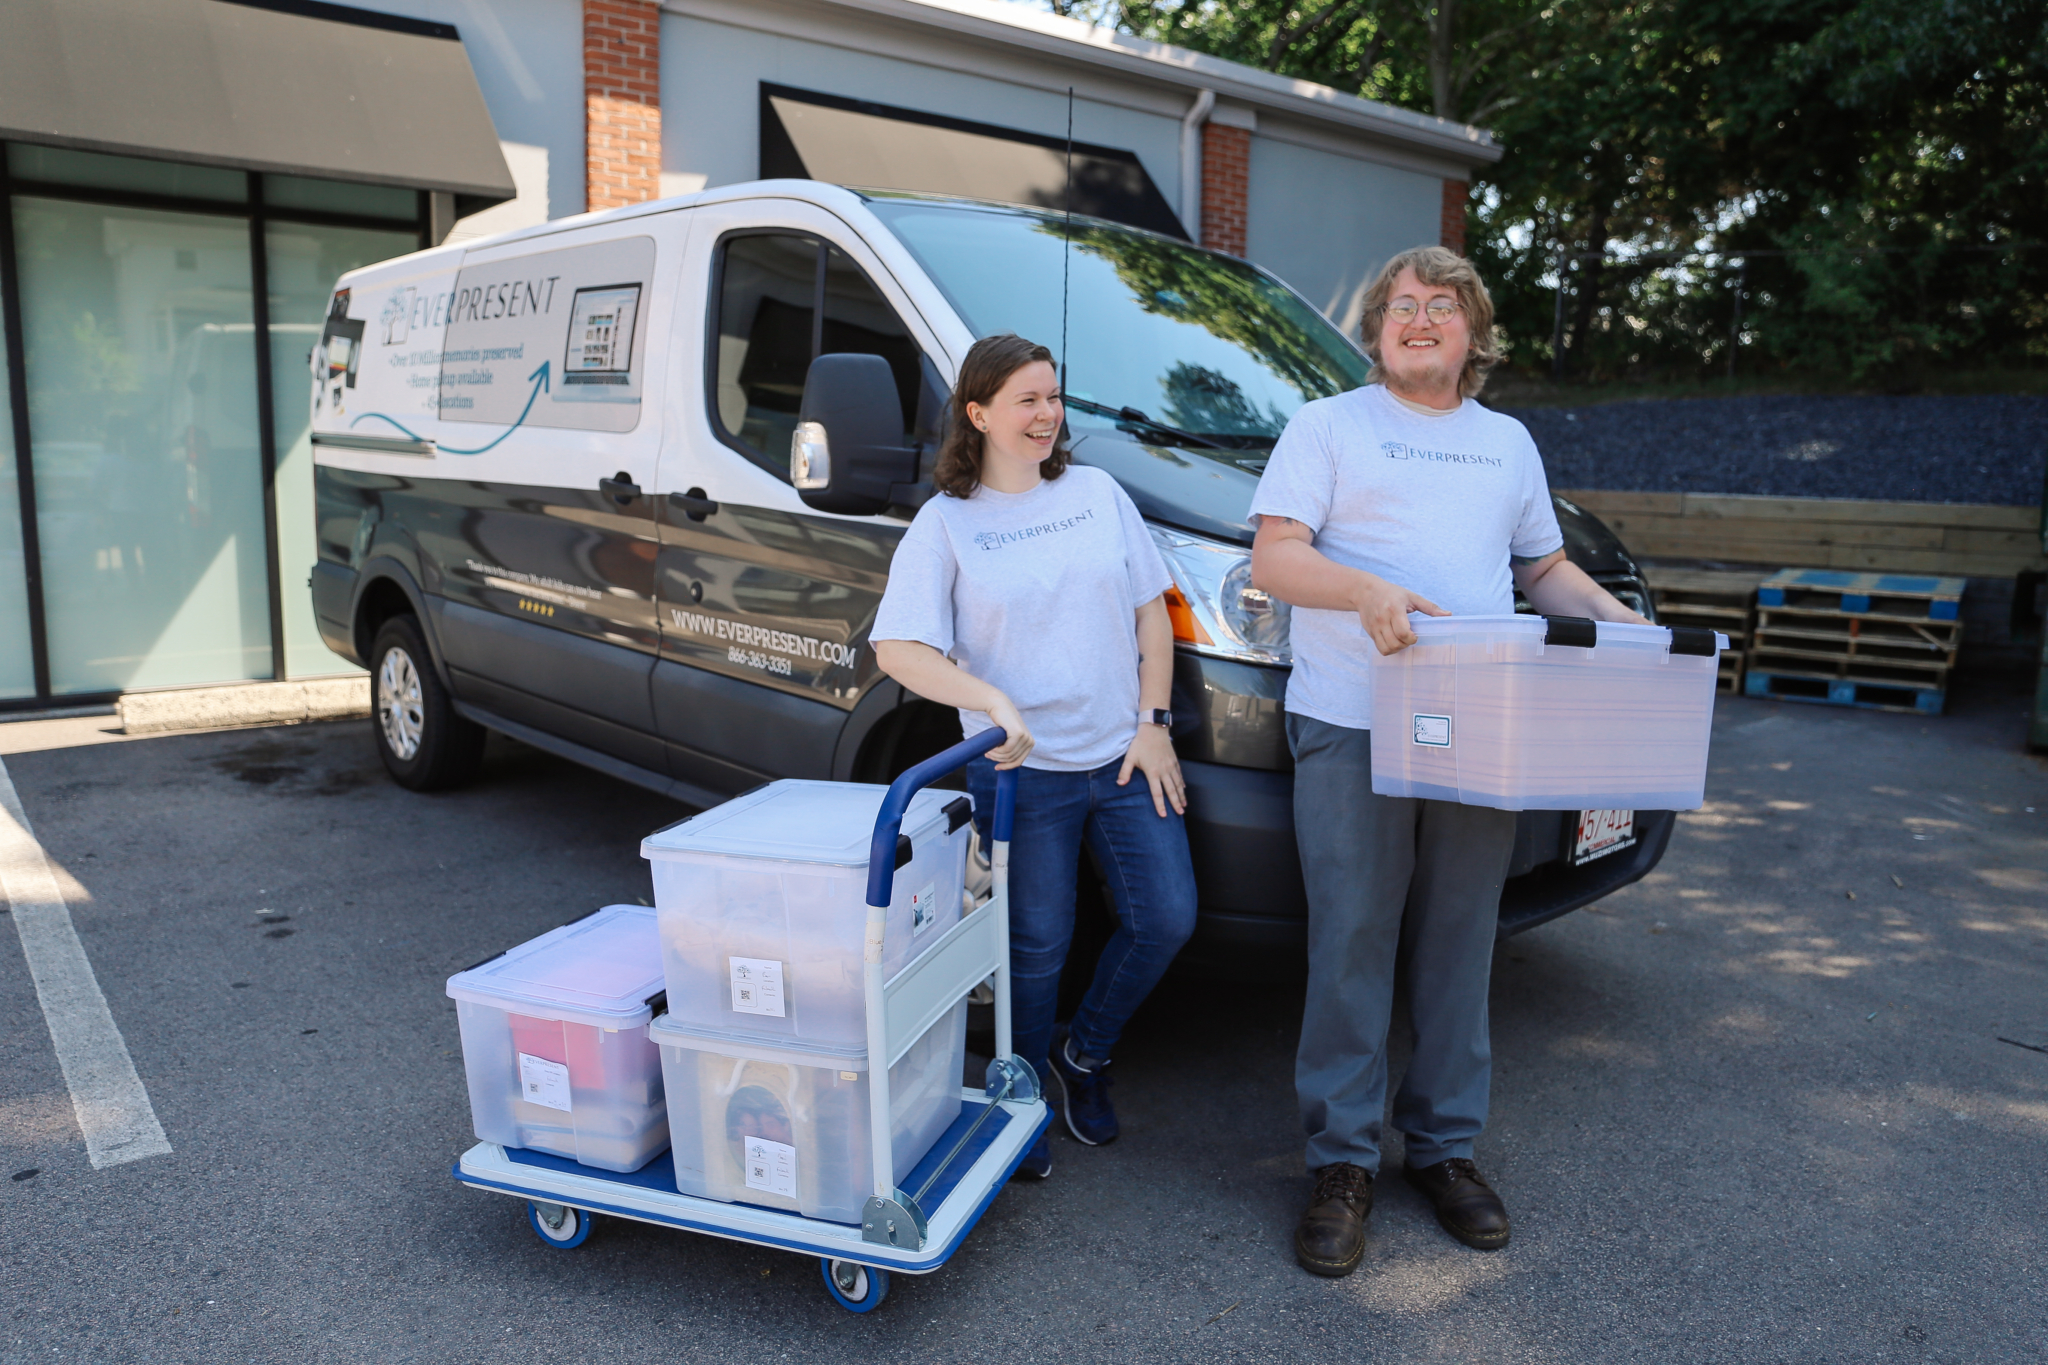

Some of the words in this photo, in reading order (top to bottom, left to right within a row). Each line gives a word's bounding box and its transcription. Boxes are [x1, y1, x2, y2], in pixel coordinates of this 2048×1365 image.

[410, 276, 561, 330] EVERPRESENT
[480, 342, 524, 364] preserved
[1410, 448, 1502, 467] EVERPRESENT
[1000, 509, 1094, 544] EVERPRESENT
[671, 609, 857, 670] WWW.EVERPRESENT.COM
[727, 646, 792, 676] 866-363-3351
